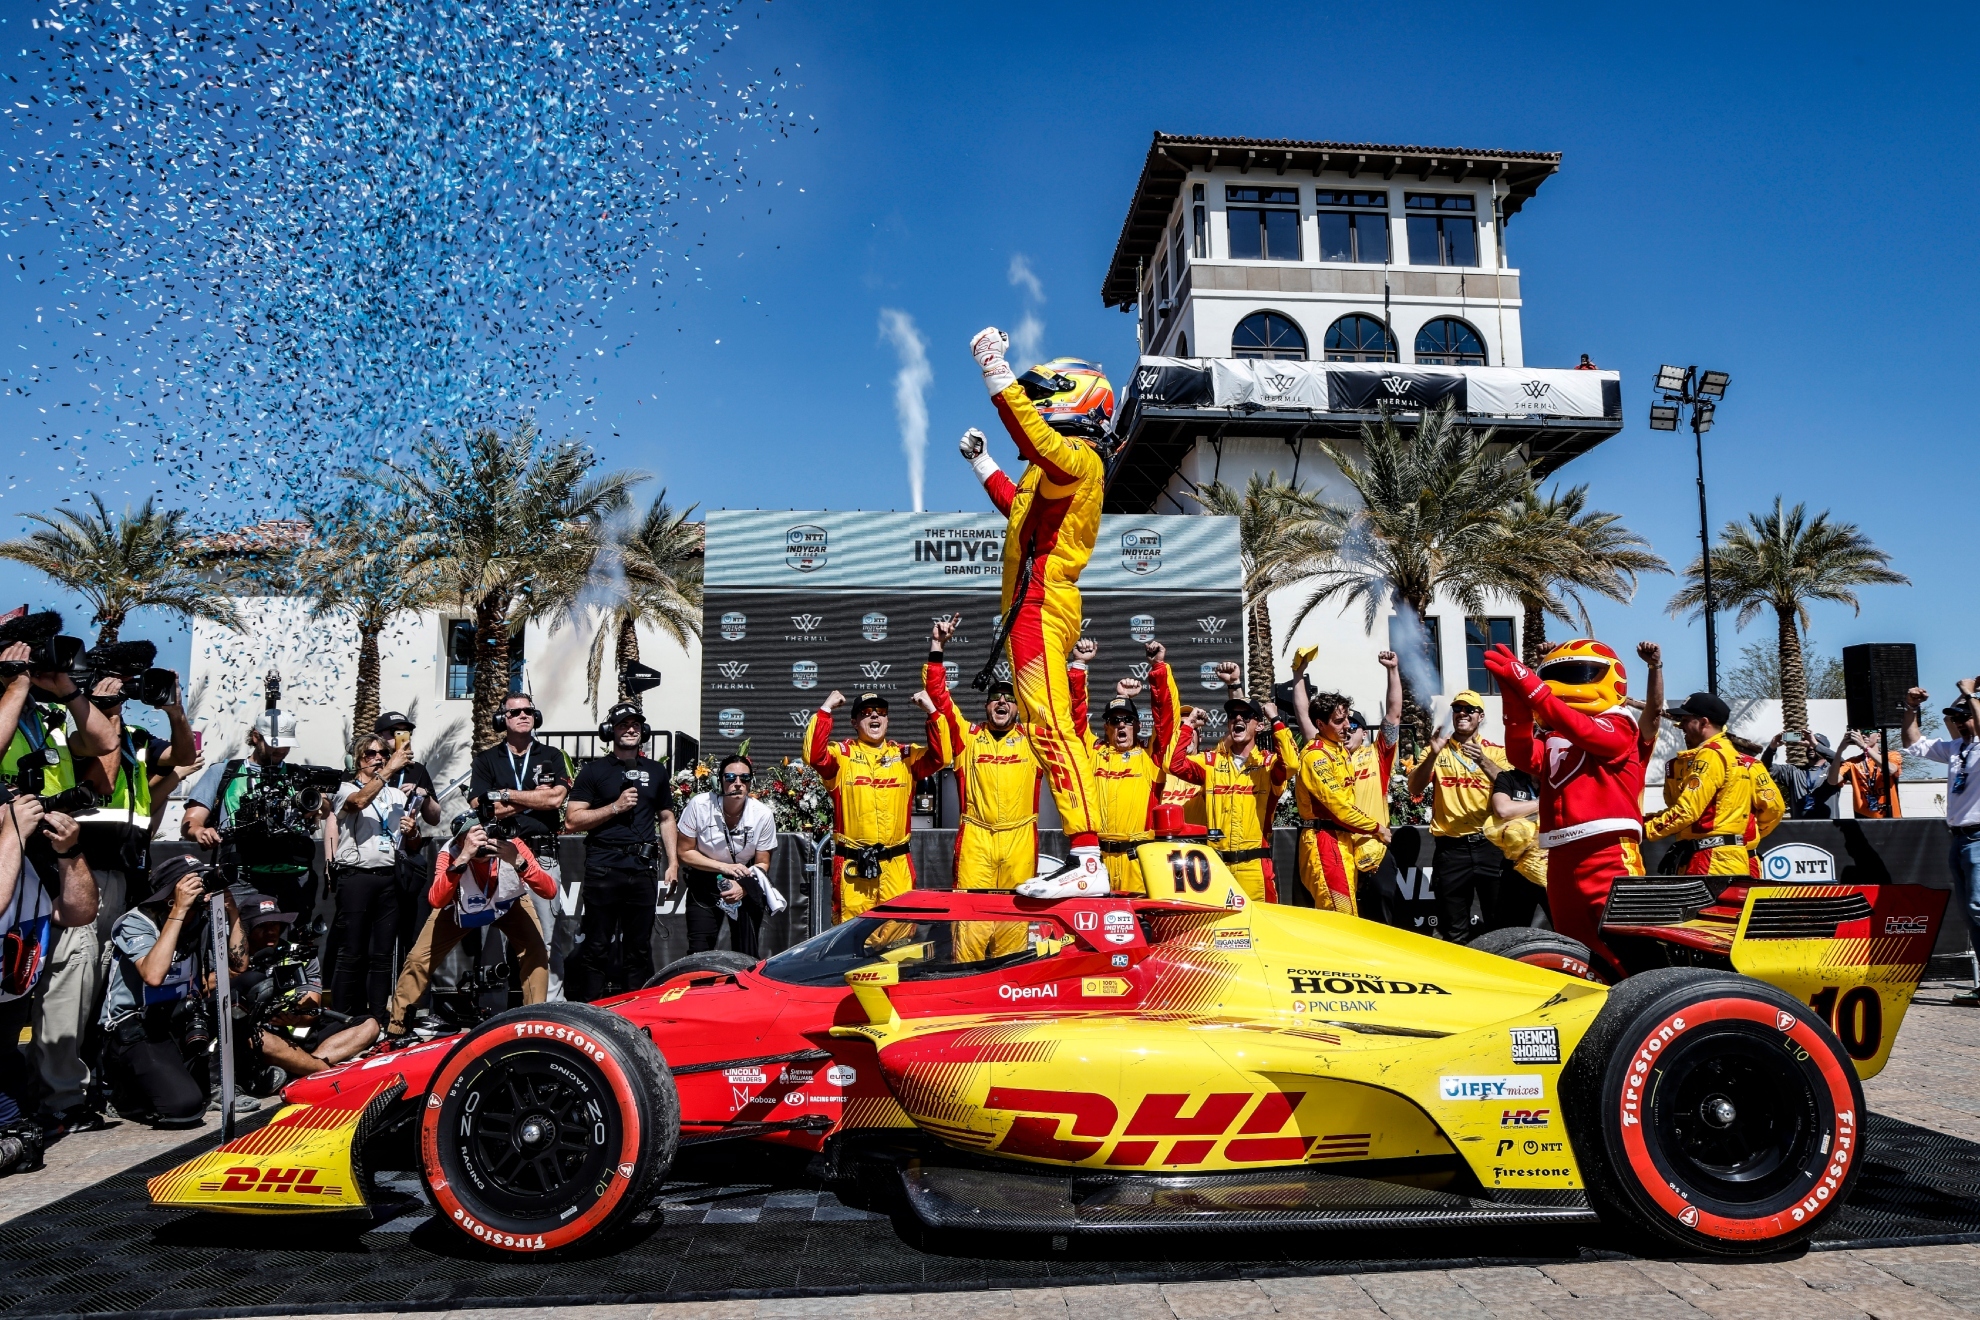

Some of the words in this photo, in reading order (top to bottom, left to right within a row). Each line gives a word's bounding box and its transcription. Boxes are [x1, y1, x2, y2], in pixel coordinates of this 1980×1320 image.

[1140, 393, 1165, 401] RMAL
[1376, 397, 1419, 407] THERMAL
[805, 533, 823, 541] NTT
[925, 529, 945, 538] THE
[948, 529, 998, 539] THERMAL
[1139, 537, 1157, 545] NTT
[786, 545, 827, 553] INDYCAR
[915, 540, 1005, 562] INDYC
[1122, 548, 1161, 556] INDYCAR
[944, 566, 981, 575] GRAND
[853, 776, 901, 788] DHL
[1167, 849, 1211, 893] 10
[1795, 859, 1828, 874] NTT
[1078, 881, 1087, 890] 10
[852, 972, 880, 981] DHL
[1287, 968, 1361, 978] POWERED
[1288, 977, 1452, 996] HONDA
[998, 984, 1058, 1002] OpenAI
[1309, 1001, 1339, 1012] PNC
[1340, 1000, 1378, 1012] BANK
[1809, 985, 1882, 1061] 10
[514, 1023, 605, 1062] Firestone
[1510, 1030, 1556, 1045] TRENCH
[1512, 1044, 1557, 1058] SHORING
[549, 1062, 589, 1093] RACING
[724, 1068, 760, 1076] LINCOLN
[829, 1072, 854, 1080] eurol
[1623, 1016, 1686, 1128] Firestone
[1506, 1085, 1540, 1096] mixes
[750, 1096, 777, 1104] Roboze
[1501, 1109, 1551, 1126] HRC
[983, 1086, 1318, 1166] DHL
[1541, 1142, 1563, 1152] NTT
[461, 1146, 485, 1190] RACING
[1791, 1110, 1855, 1222] Firestone
[1493, 1167, 1571, 1179] Firestone
[219, 1166, 324, 1195] DHL
[454, 1208, 546, 1250] Firestone
